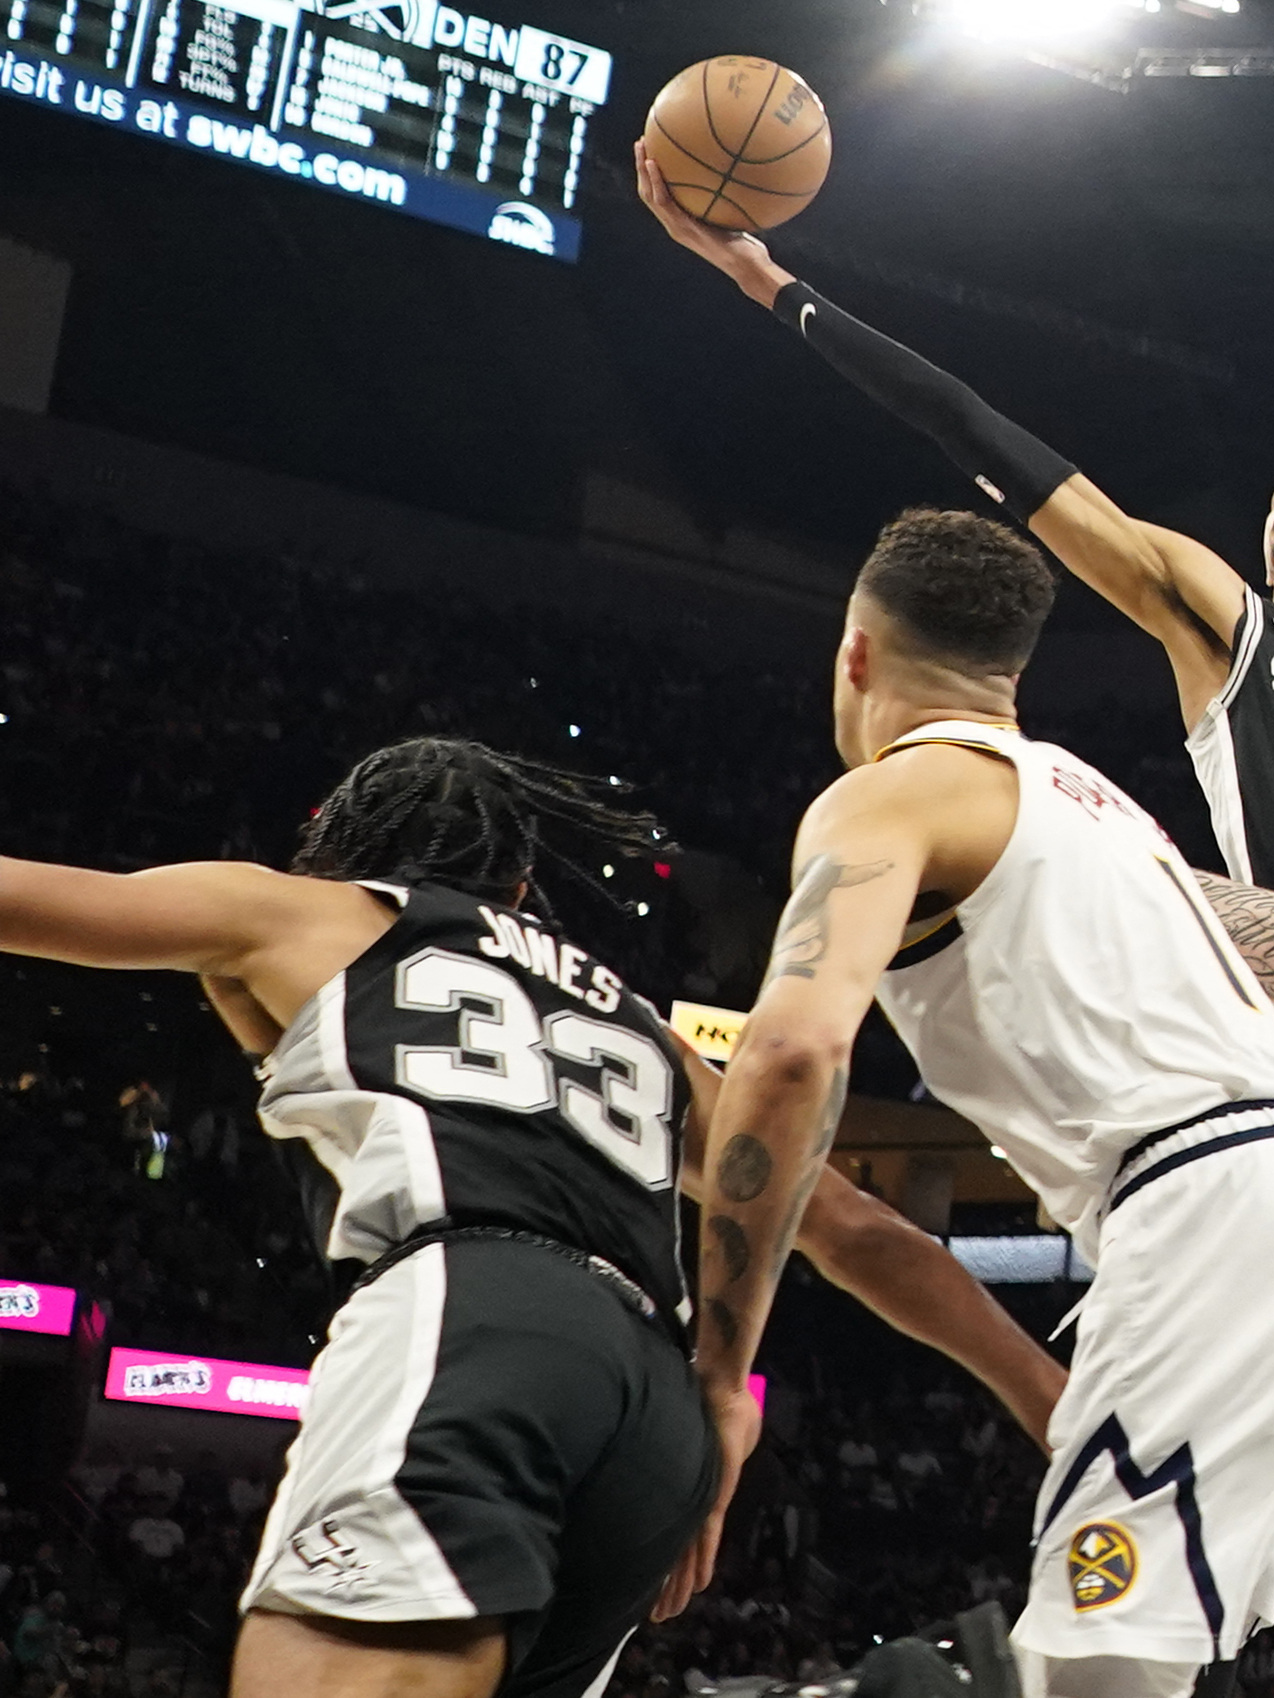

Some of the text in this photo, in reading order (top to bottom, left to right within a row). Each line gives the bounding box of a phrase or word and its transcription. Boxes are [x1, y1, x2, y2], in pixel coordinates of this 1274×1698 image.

[434, 5, 519, 67] DEN
[540, 43, 589, 86] 87
[0, 50, 64, 104] isit
[74, 80, 125, 121] us
[135, 99, 180, 138] at
[186, 114, 408, 206] swbc.com
[477, 904, 623, 1014] JONES
[394, 946, 674, 1192] 33
